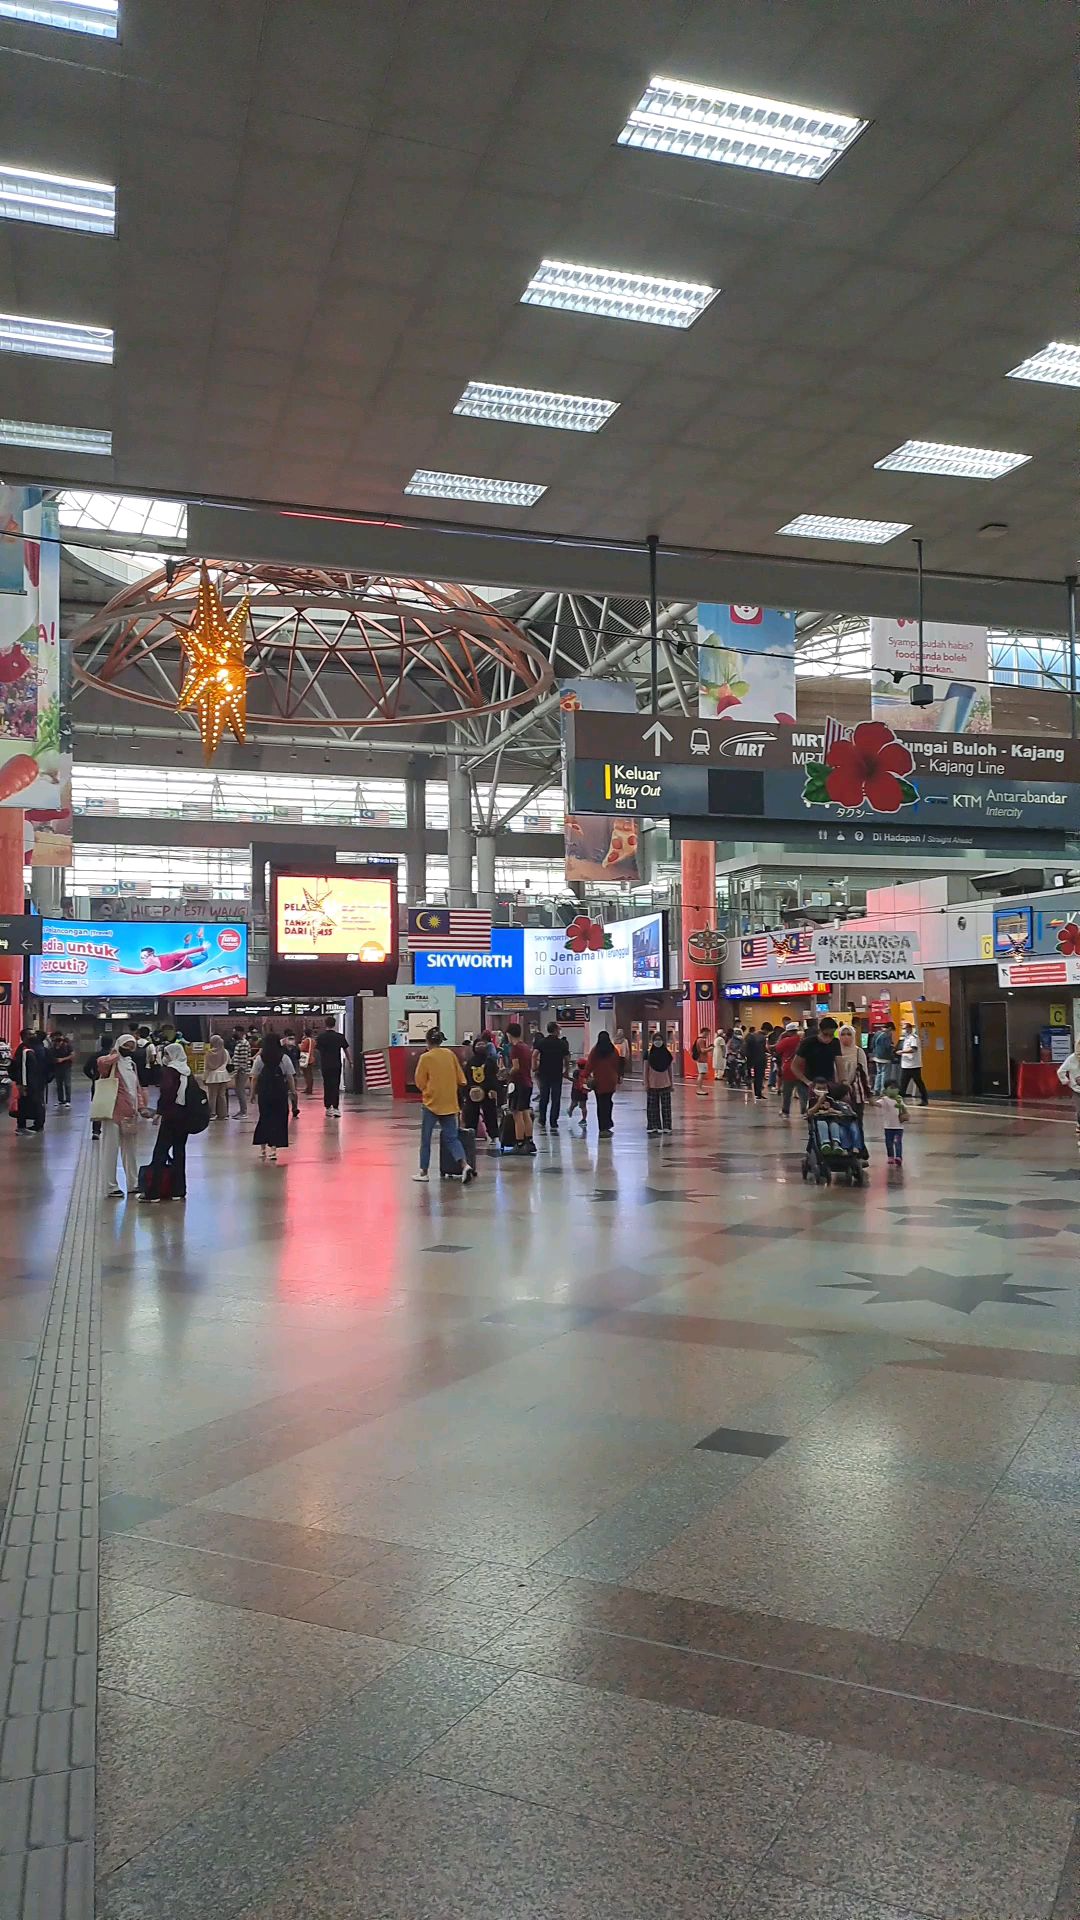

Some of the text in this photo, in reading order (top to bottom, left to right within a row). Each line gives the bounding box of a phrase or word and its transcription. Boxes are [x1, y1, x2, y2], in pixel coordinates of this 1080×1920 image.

[923, 640, 948, 650] sudah
[948, 641, 974, 651] habis?
[943, 653, 968, 662] boleh
[734, 743, 766, 757] MRT
[791, 733, 825, 748] MRT
[953, 742, 997, 756] Buloh
[1011, 745, 1065, 762] Kajang
[614, 765, 661, 781] Keluar
[929, 759, 974, 776] Kajang
[978, 761, 1005, 775] Line
[615, 783, 662, 797] Way Out
[615, 798, 637, 809] 出口
[952, 788, 1068, 808] KTM Antarabandar
[835, 807, 875, 818] タクシー
[985, 806, 1023, 820] Intercity
[872, 832, 882, 841] Di
[884, 833, 921, 844] Hadapan
[284, 927, 307, 935] DARI
[43, 939, 115, 957] edia untuk
[818, 934, 911, 949] #KELUARGA
[984, 941, 991, 954] C
[426, 954, 513, 968] SKYWORTH
[534, 952, 547, 962] 10
[550, 951, 595, 962] Jenama
[829, 950, 907, 964] MALAYSIA
[534, 964, 583, 976] di Dunia
[815, 970, 916, 981] TEGUH BERSAMA
[741, 985, 751, 996] 24
[771, 981, 814, 994] McDonald's
[1053, 1010, 1063, 1023] C
